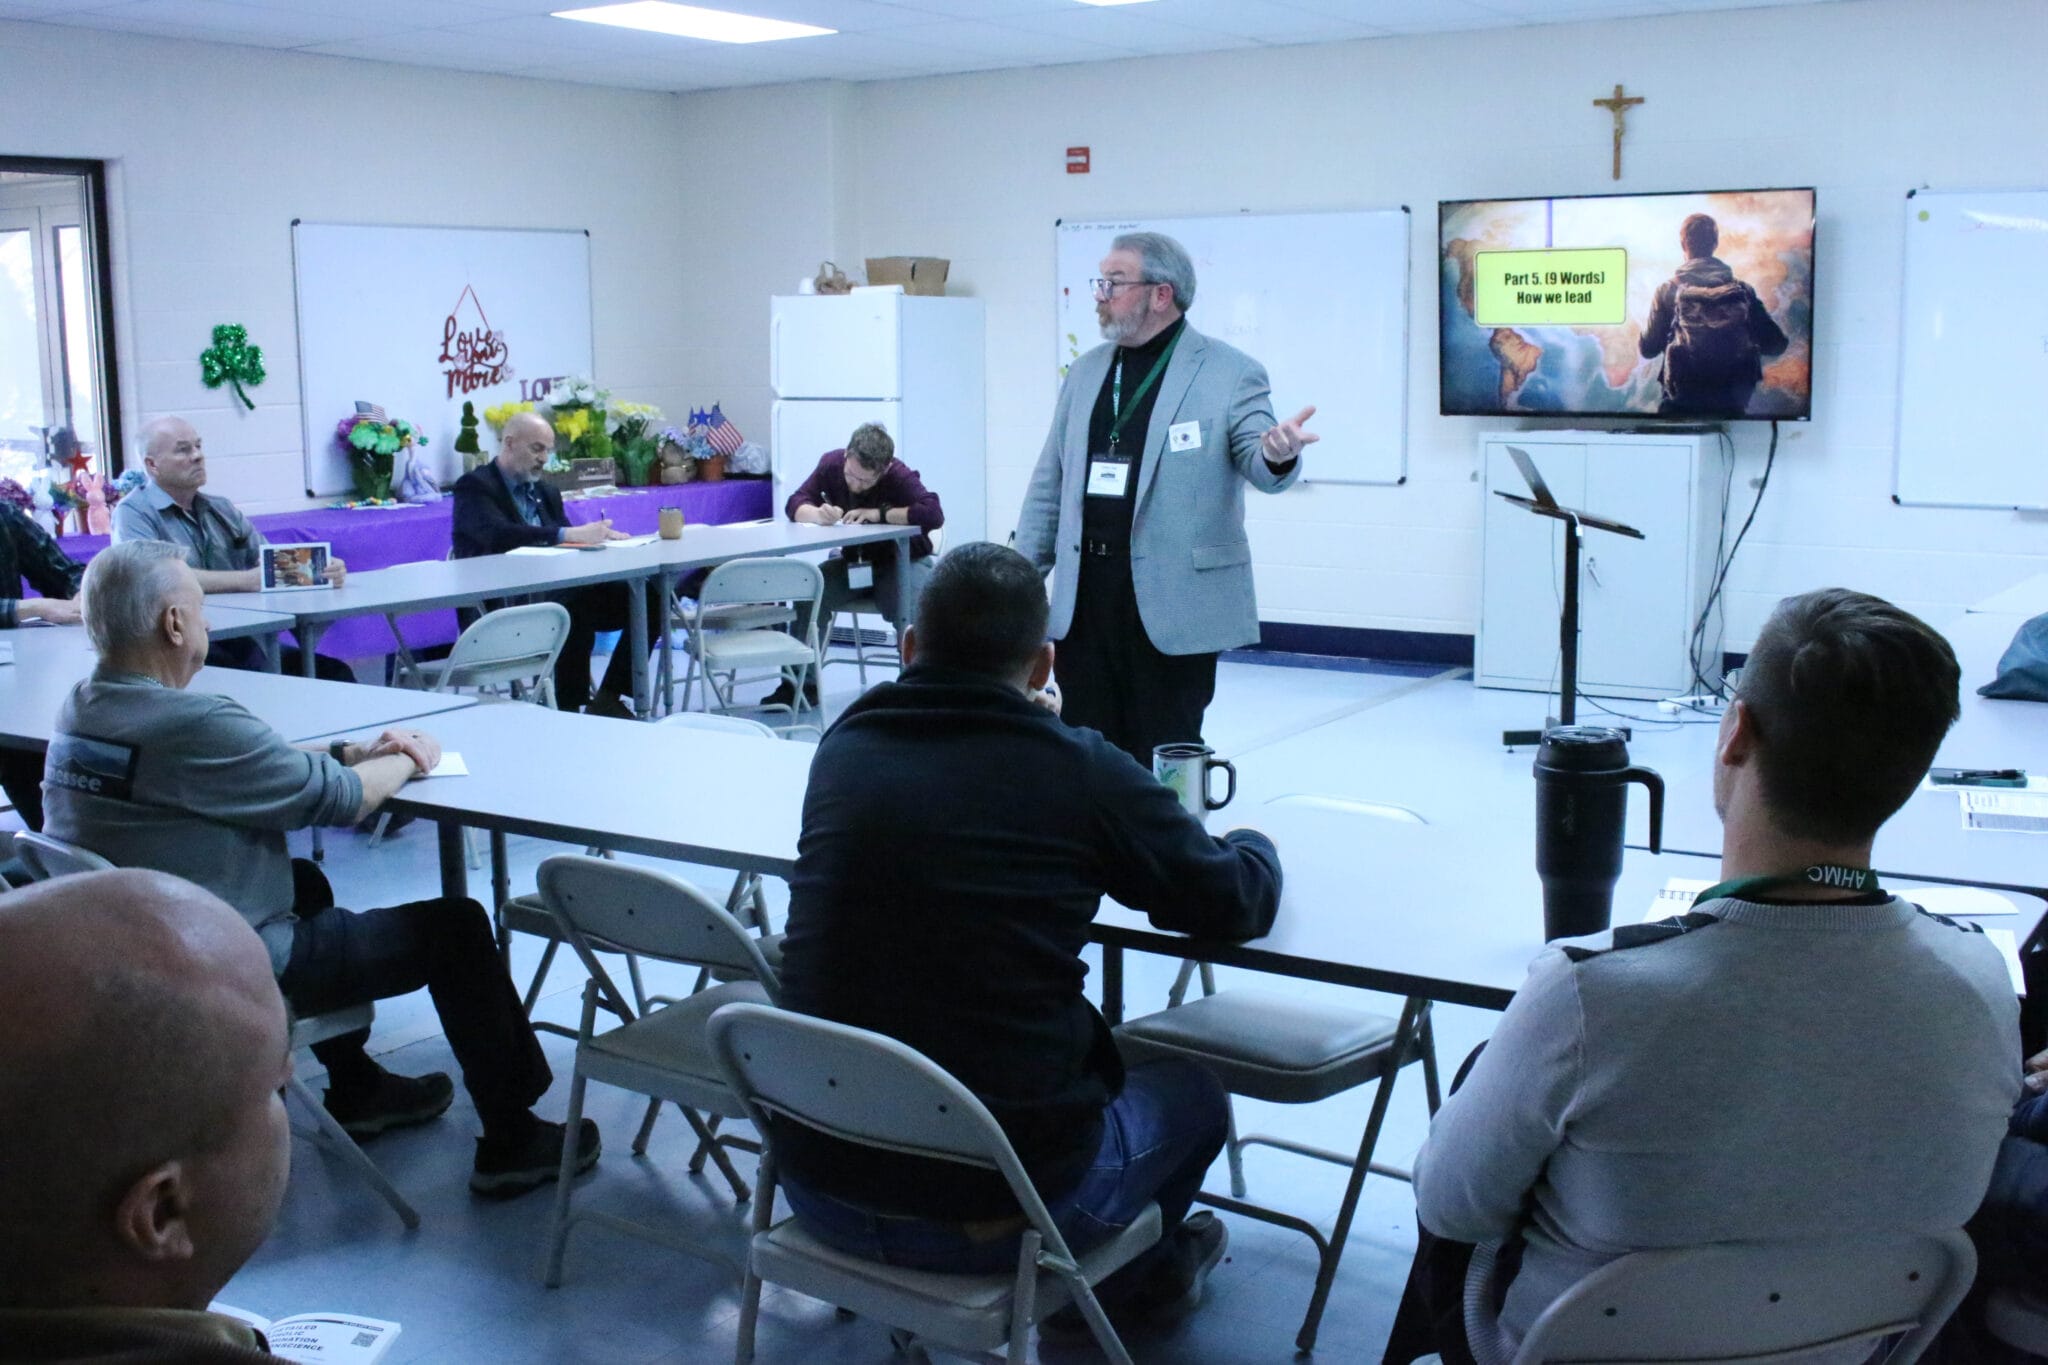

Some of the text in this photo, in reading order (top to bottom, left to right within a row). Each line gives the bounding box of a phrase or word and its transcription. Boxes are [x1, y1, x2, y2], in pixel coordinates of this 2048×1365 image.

[1504, 271, 1605, 287] Part 5. (9 Words)
[1517, 290, 1592, 304] How we lead
[439, 315, 495, 362] Love
[1806, 865, 1866, 889] AHMC
